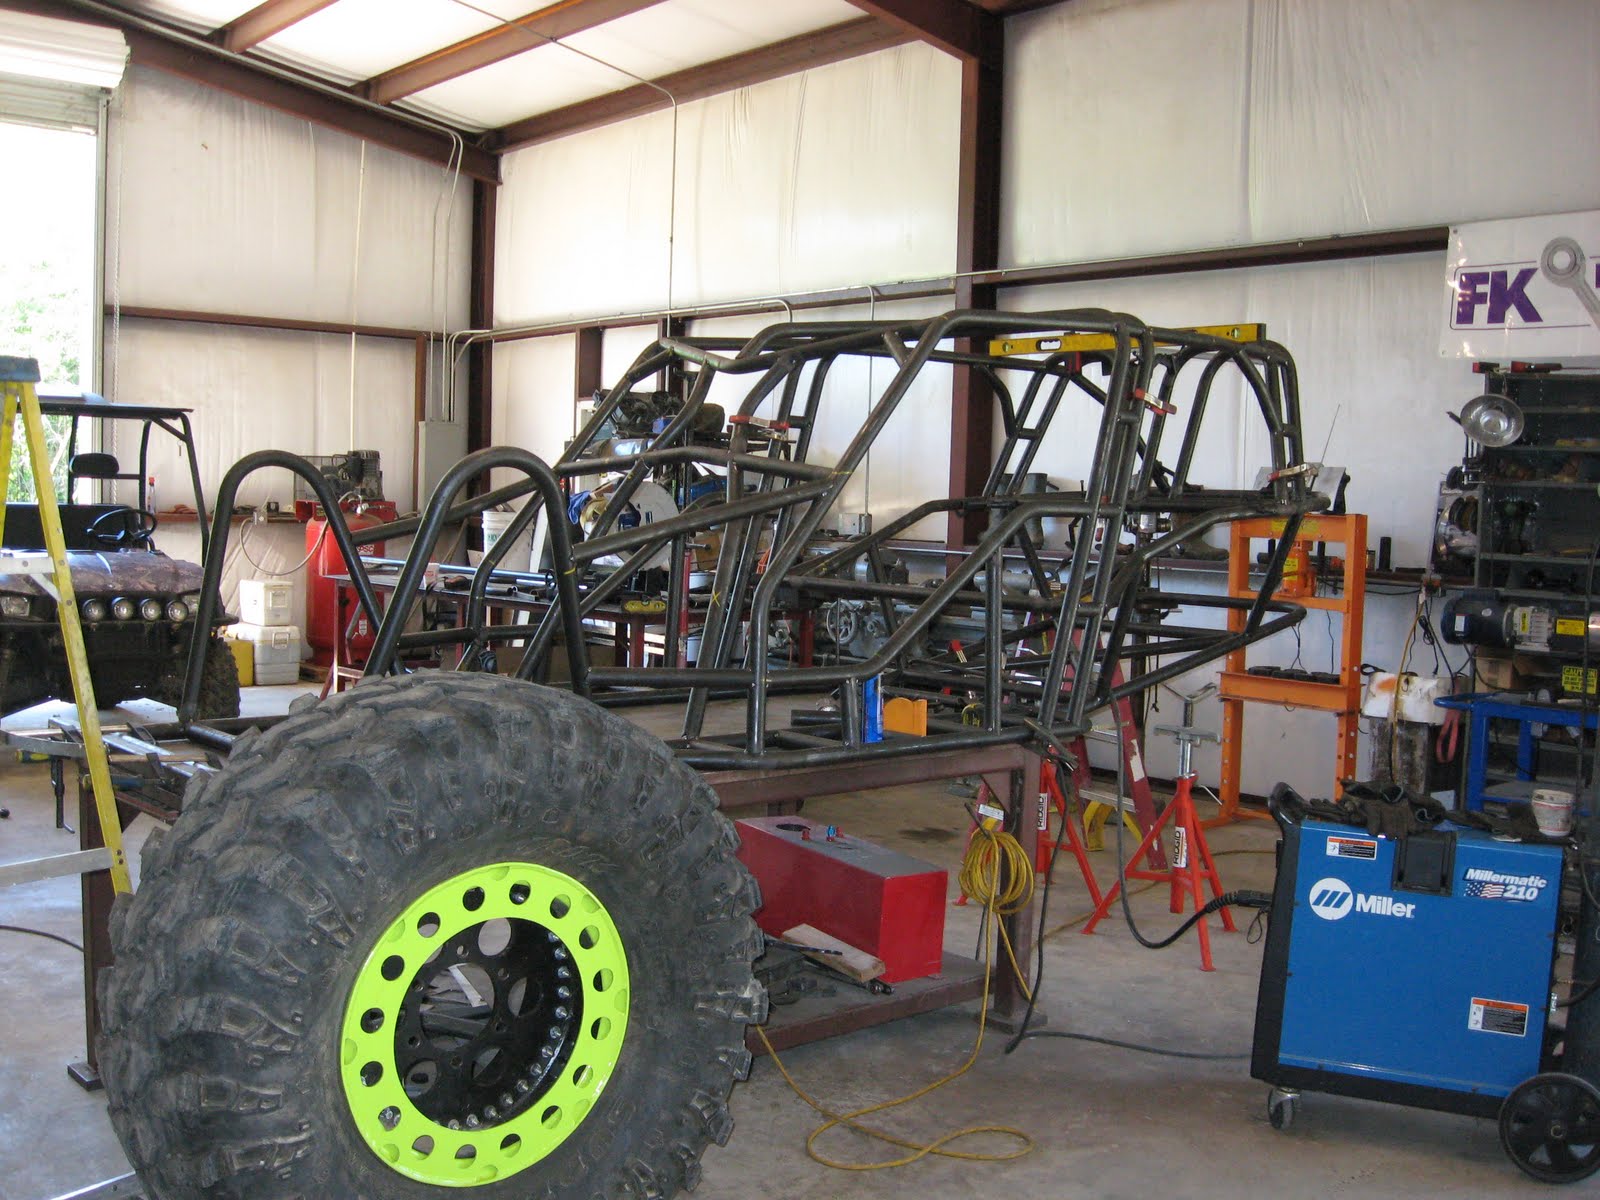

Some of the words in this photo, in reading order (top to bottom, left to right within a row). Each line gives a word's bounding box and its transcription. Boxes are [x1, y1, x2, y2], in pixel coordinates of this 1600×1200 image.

[1456, 268, 1544, 325] FK
[1564, 668, 1597, 678] CAUTON
[1173, 830, 1181, 865] RIDGID
[1465, 868, 1548, 888] Millermatic
[1502, 885, 1539, 901] 210
[1355, 893, 1416, 918] Miller
